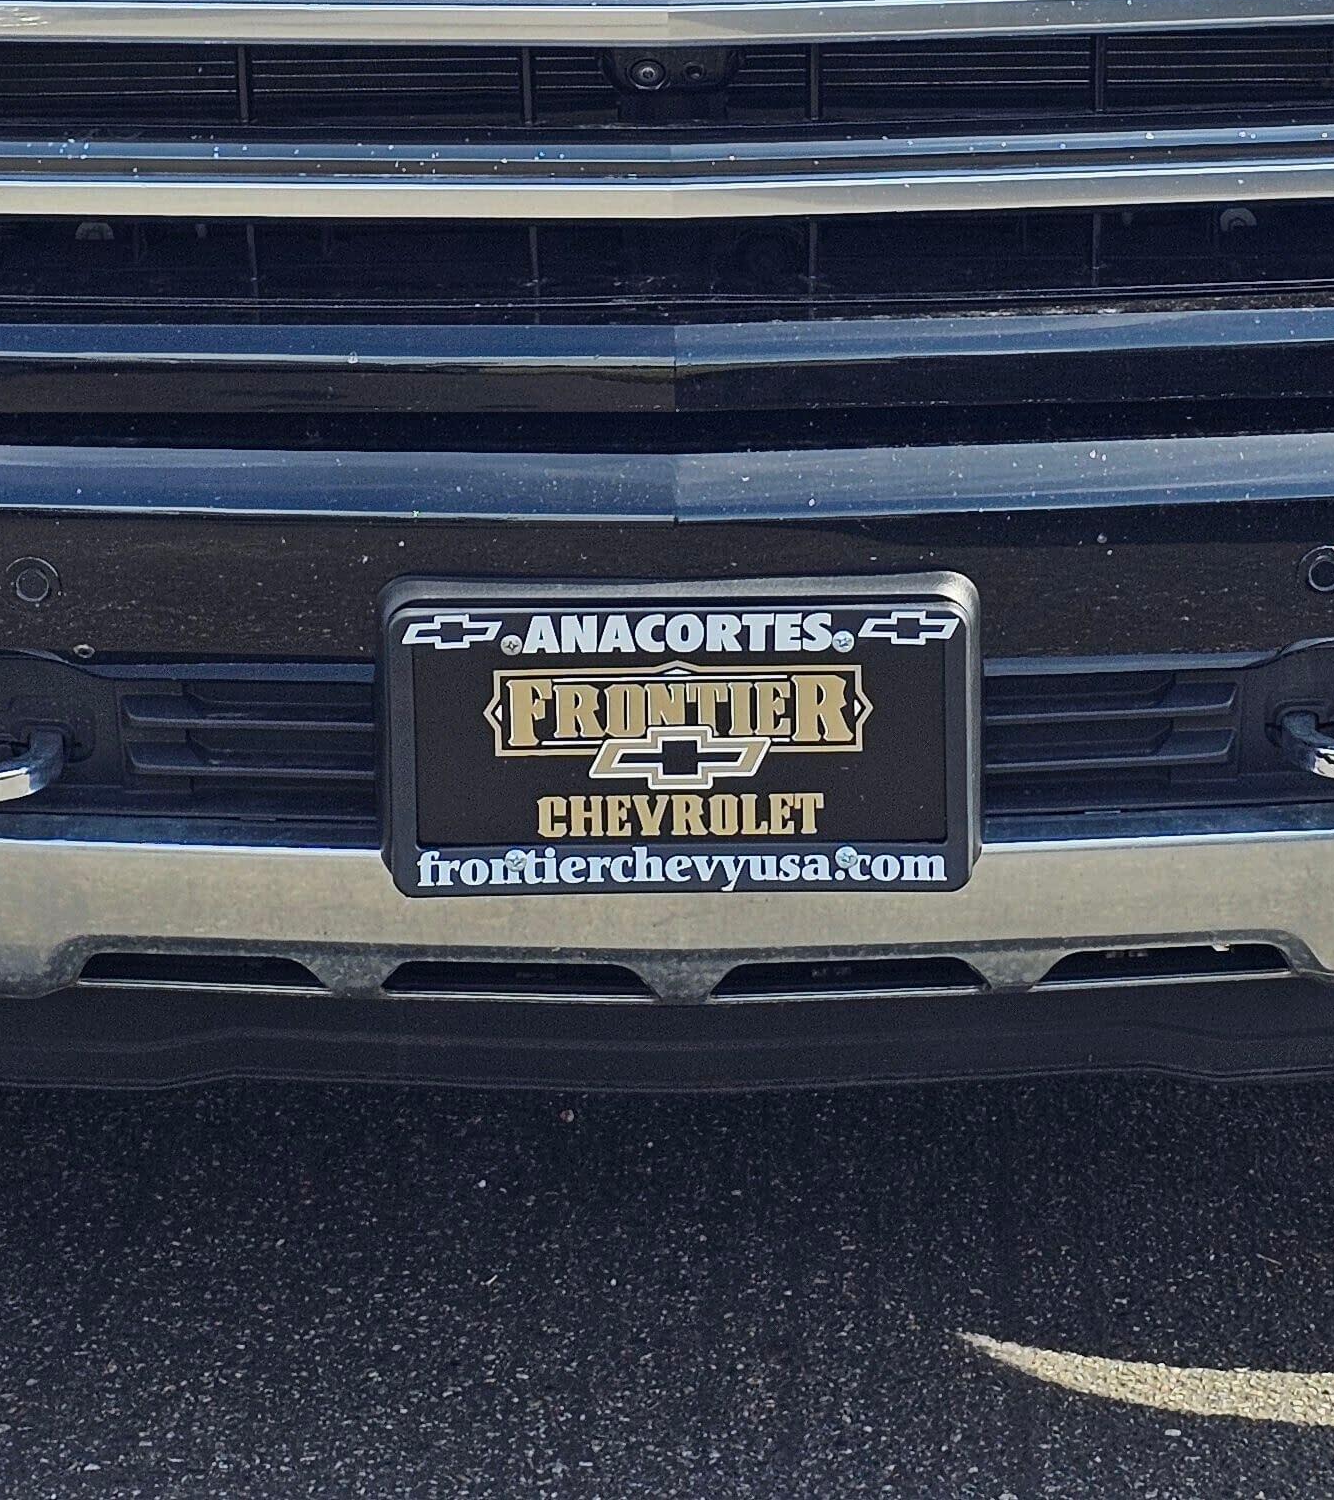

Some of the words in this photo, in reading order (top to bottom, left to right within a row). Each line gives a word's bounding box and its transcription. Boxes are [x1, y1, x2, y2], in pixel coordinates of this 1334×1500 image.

[522, 612, 834, 654] ANACORTES
[506, 675, 854, 747] FRONTIER
[536, 793, 824, 837] CHEVROLET
[417, 847, 947, 891] frontierchevyusa.com
